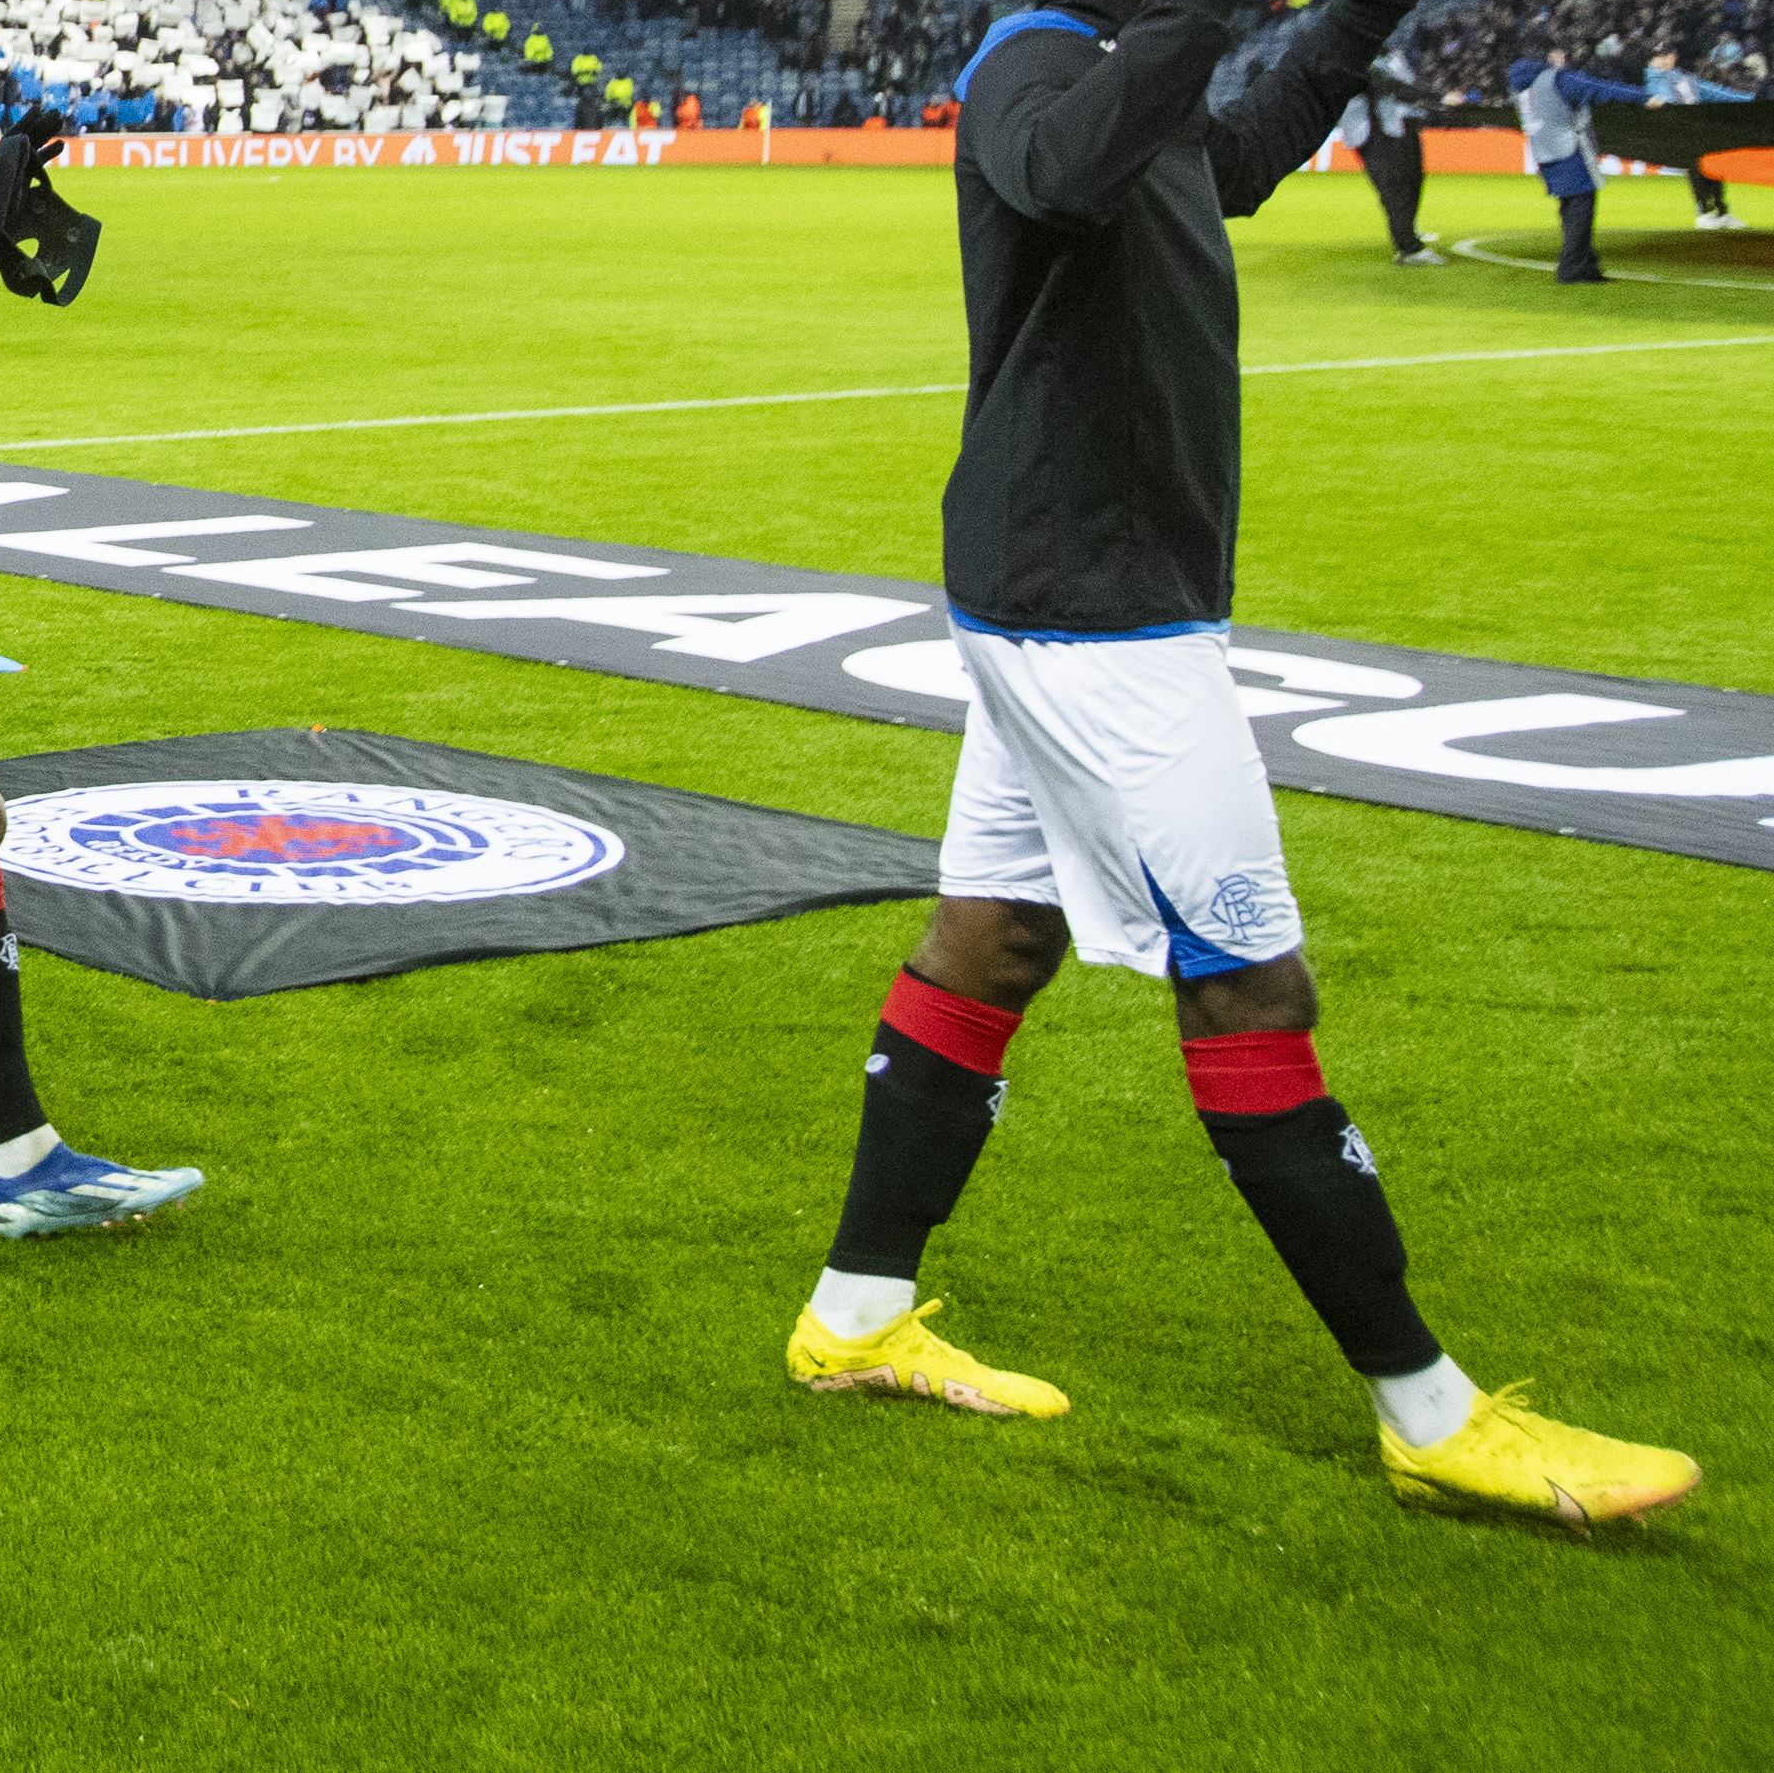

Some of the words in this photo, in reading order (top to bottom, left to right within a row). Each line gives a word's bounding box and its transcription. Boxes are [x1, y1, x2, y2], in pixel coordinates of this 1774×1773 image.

[453, 130, 562, 165] JUST
[570, 130, 677, 165] EAT
[235, 788, 575, 863] RANGERS
[184, 877, 413, 893] CLUB
